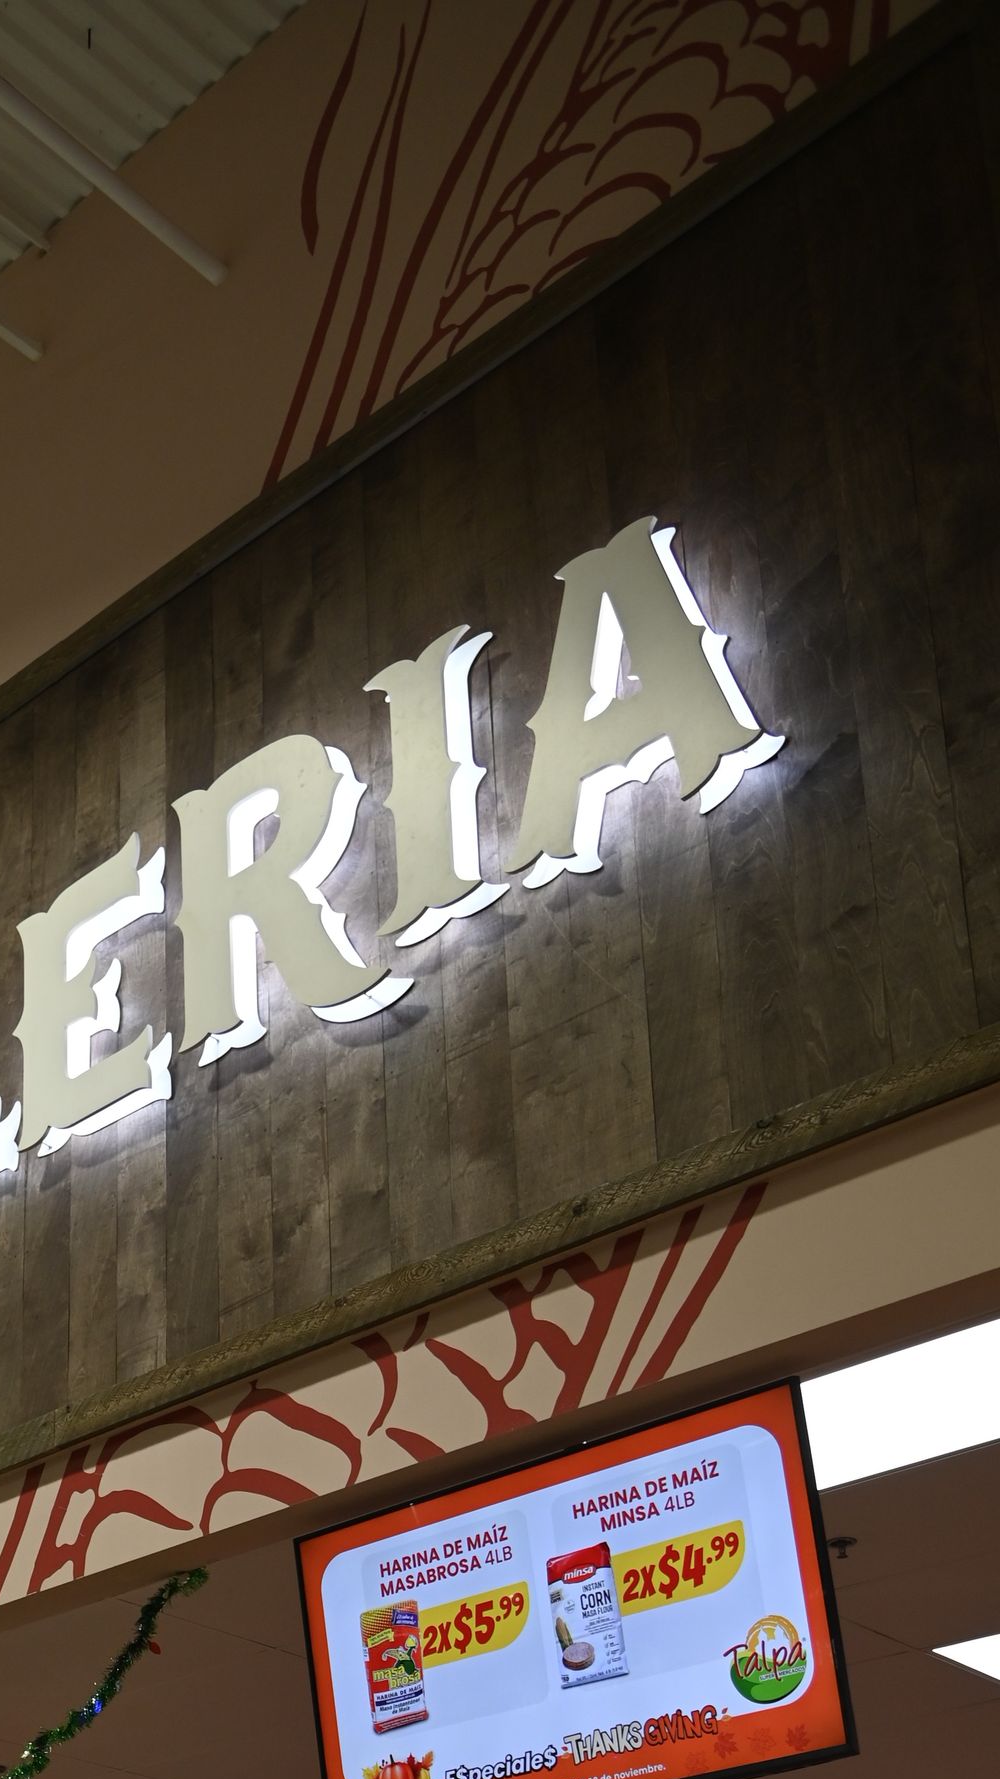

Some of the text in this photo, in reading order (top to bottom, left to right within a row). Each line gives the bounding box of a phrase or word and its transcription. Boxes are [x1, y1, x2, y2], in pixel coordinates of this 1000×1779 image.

[572, 1460, 719, 1519] HARINA DE MAÍZ
[601, 1492, 695, 1532] MINSA 4LB
[380, 1524, 508, 1577] HARINA DE MAÍZ
[380, 1546, 512, 1597] MASABROSA 4LB
[583, 1581, 604, 1592] INSTANT
[580, 1589, 612, 1610] CORN
[582, 1605, 613, 1619] MASA FLOUR
[374, 1665, 404, 1681] masa
[723, 1640, 806, 1681] Talpa
[613, 1764, 666, 1779] noviembre.
